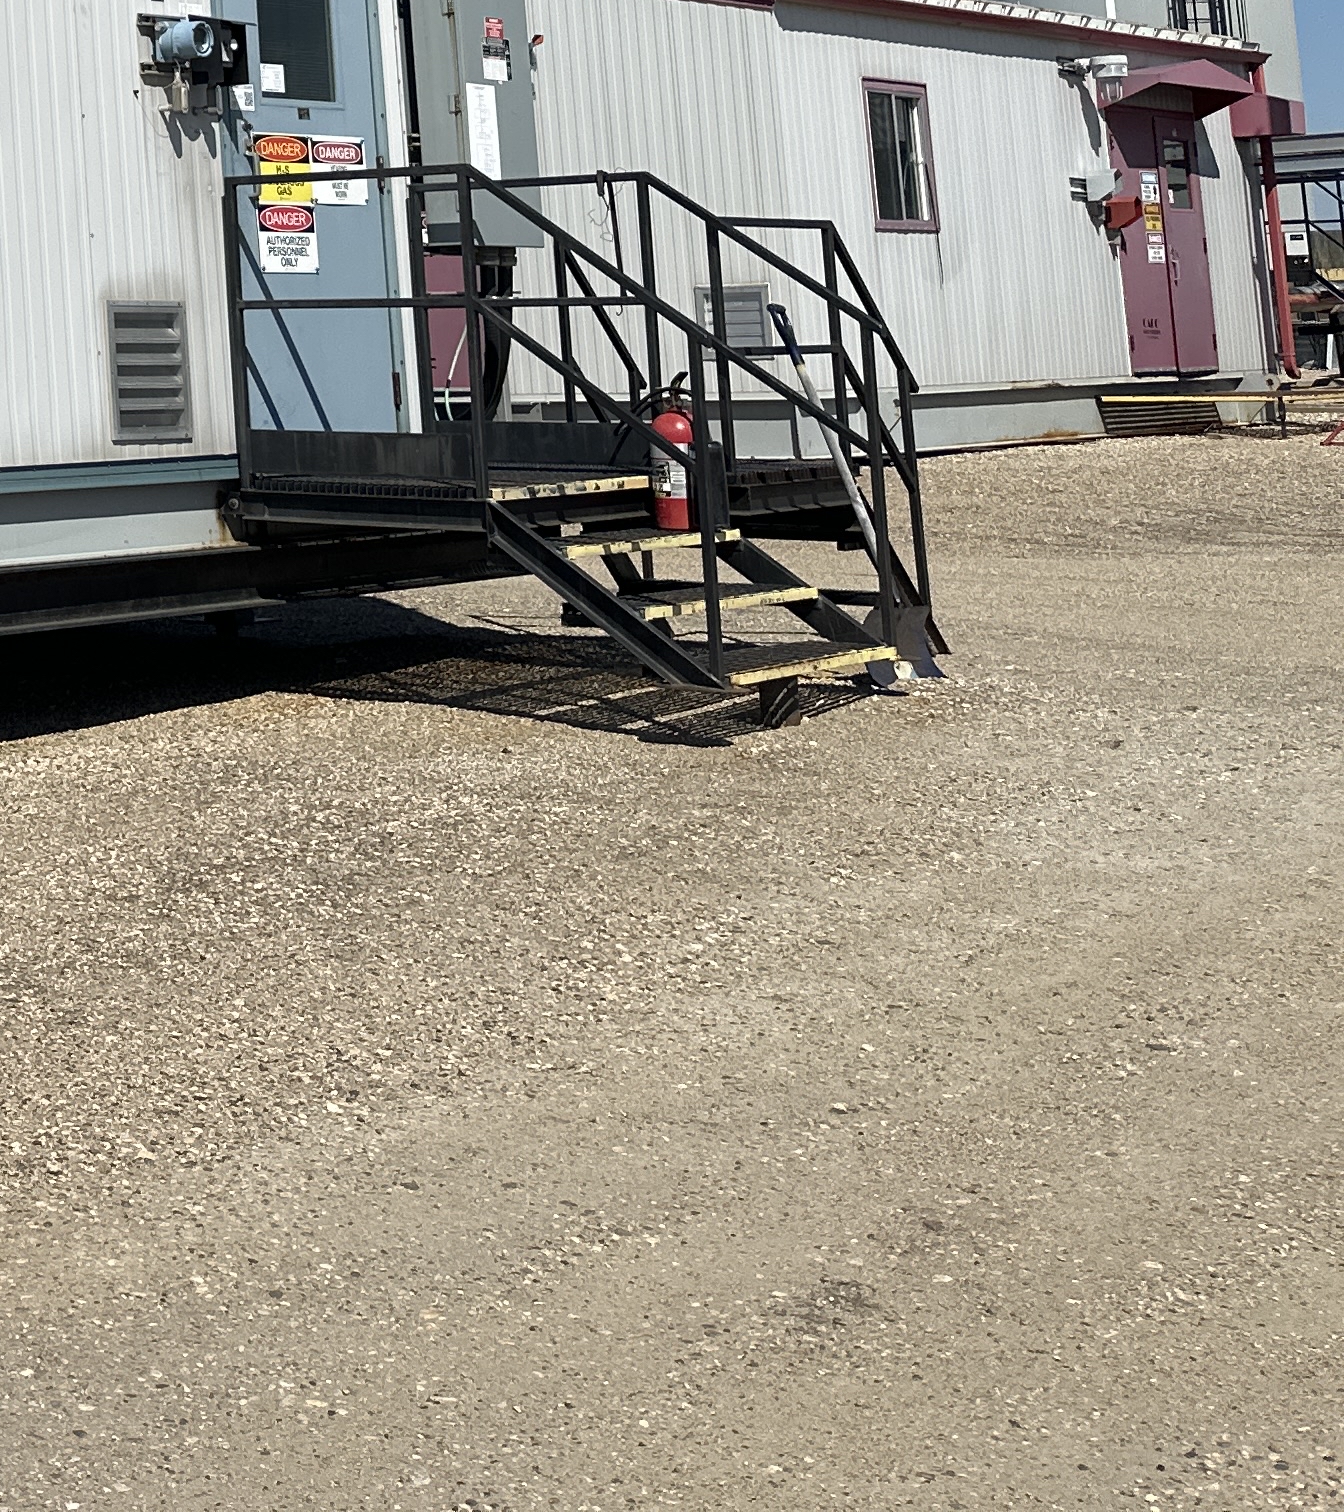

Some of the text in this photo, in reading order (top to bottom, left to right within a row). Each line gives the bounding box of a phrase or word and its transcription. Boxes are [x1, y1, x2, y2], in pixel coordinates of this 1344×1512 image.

[261, 142, 301, 157] DANGER
[318, 146, 356, 159] DANGER
[277, 186, 292, 195] GAS
[265, 211, 306, 225] DANGER
[267, 236, 310, 246] AUTHORIZED
[268, 246, 309, 256] PERSONNEL
[281, 257, 298, 267] ONLY
